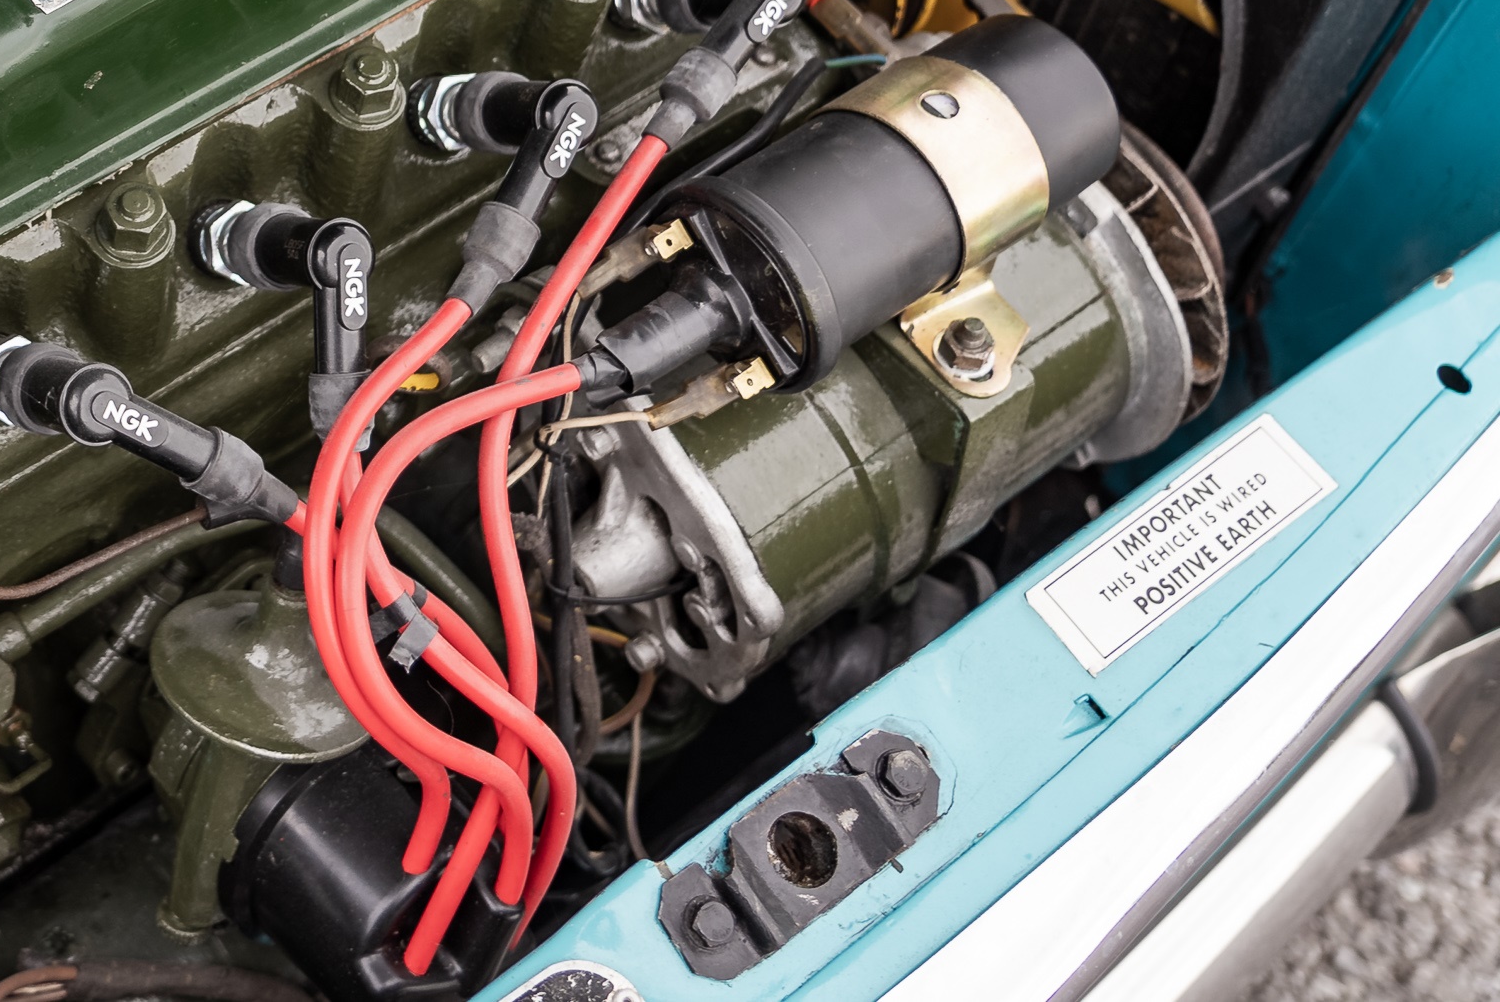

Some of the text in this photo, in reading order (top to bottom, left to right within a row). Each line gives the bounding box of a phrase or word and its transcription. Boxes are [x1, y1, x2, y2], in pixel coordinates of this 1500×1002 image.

[550, 112, 586, 168] NGK
[344, 258, 364, 317] NGK
[102, 400, 159, 442] NGK
[1100, 472, 1267, 602] THIS VEHICLE IS WIRED
[1113, 474, 1222, 561] IMPORTANT
[1133, 500, 1277, 615] POSITIVE EARTH
